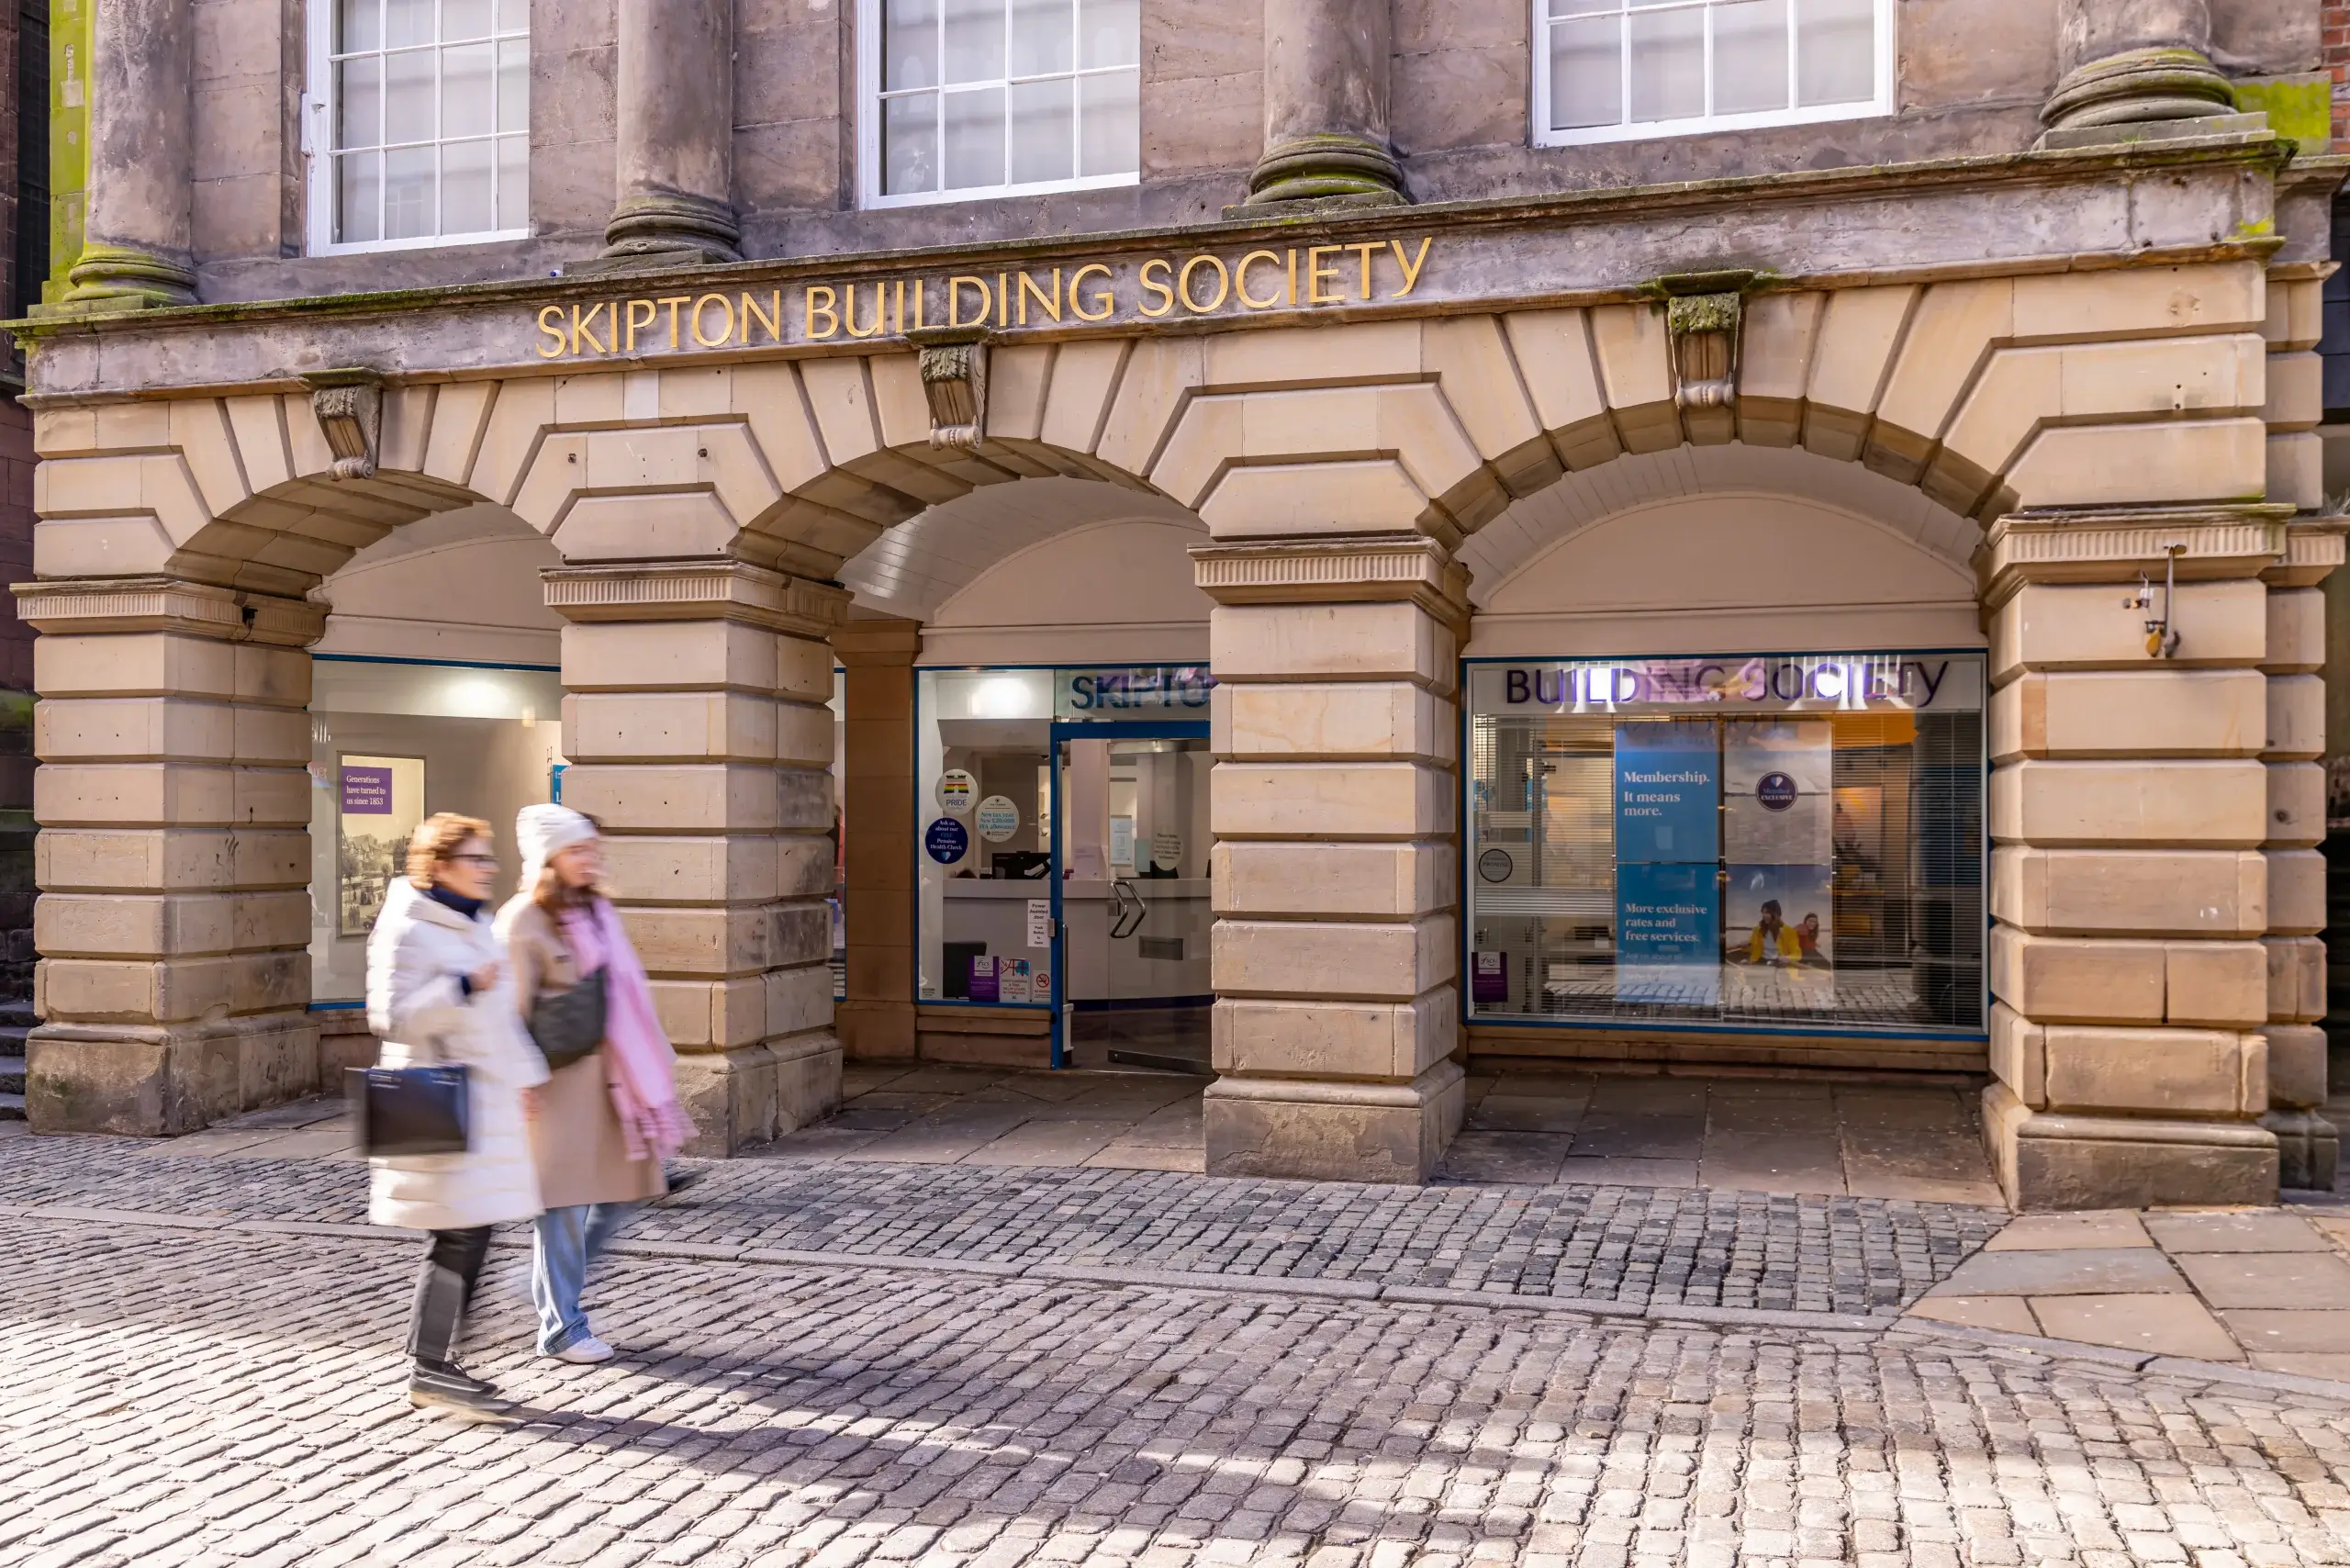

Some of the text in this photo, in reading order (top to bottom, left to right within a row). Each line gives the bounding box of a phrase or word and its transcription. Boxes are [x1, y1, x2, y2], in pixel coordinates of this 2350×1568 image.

[535, 237, 1432, 358] SKIPTON BUILDING SOCIETY
[1506, 660, 1949, 709] BUILDING SOCIETY
[1070, 674, 1210, 710] SKIPTO
[346, 775, 380, 784] Generations
[1624, 771, 1710, 785] Membership.
[346, 785, 386, 795] have turned to
[354, 796, 369, 805] since
[370, 797, 384, 805] 1853
[1624, 790, 1681, 802] It means
[1624, 807, 1662, 816] more.
[1625, 903, 1707, 914] More exclusive
[1625, 918, 1676, 927] rates and
[1625, 931, 1699, 942] free services.
